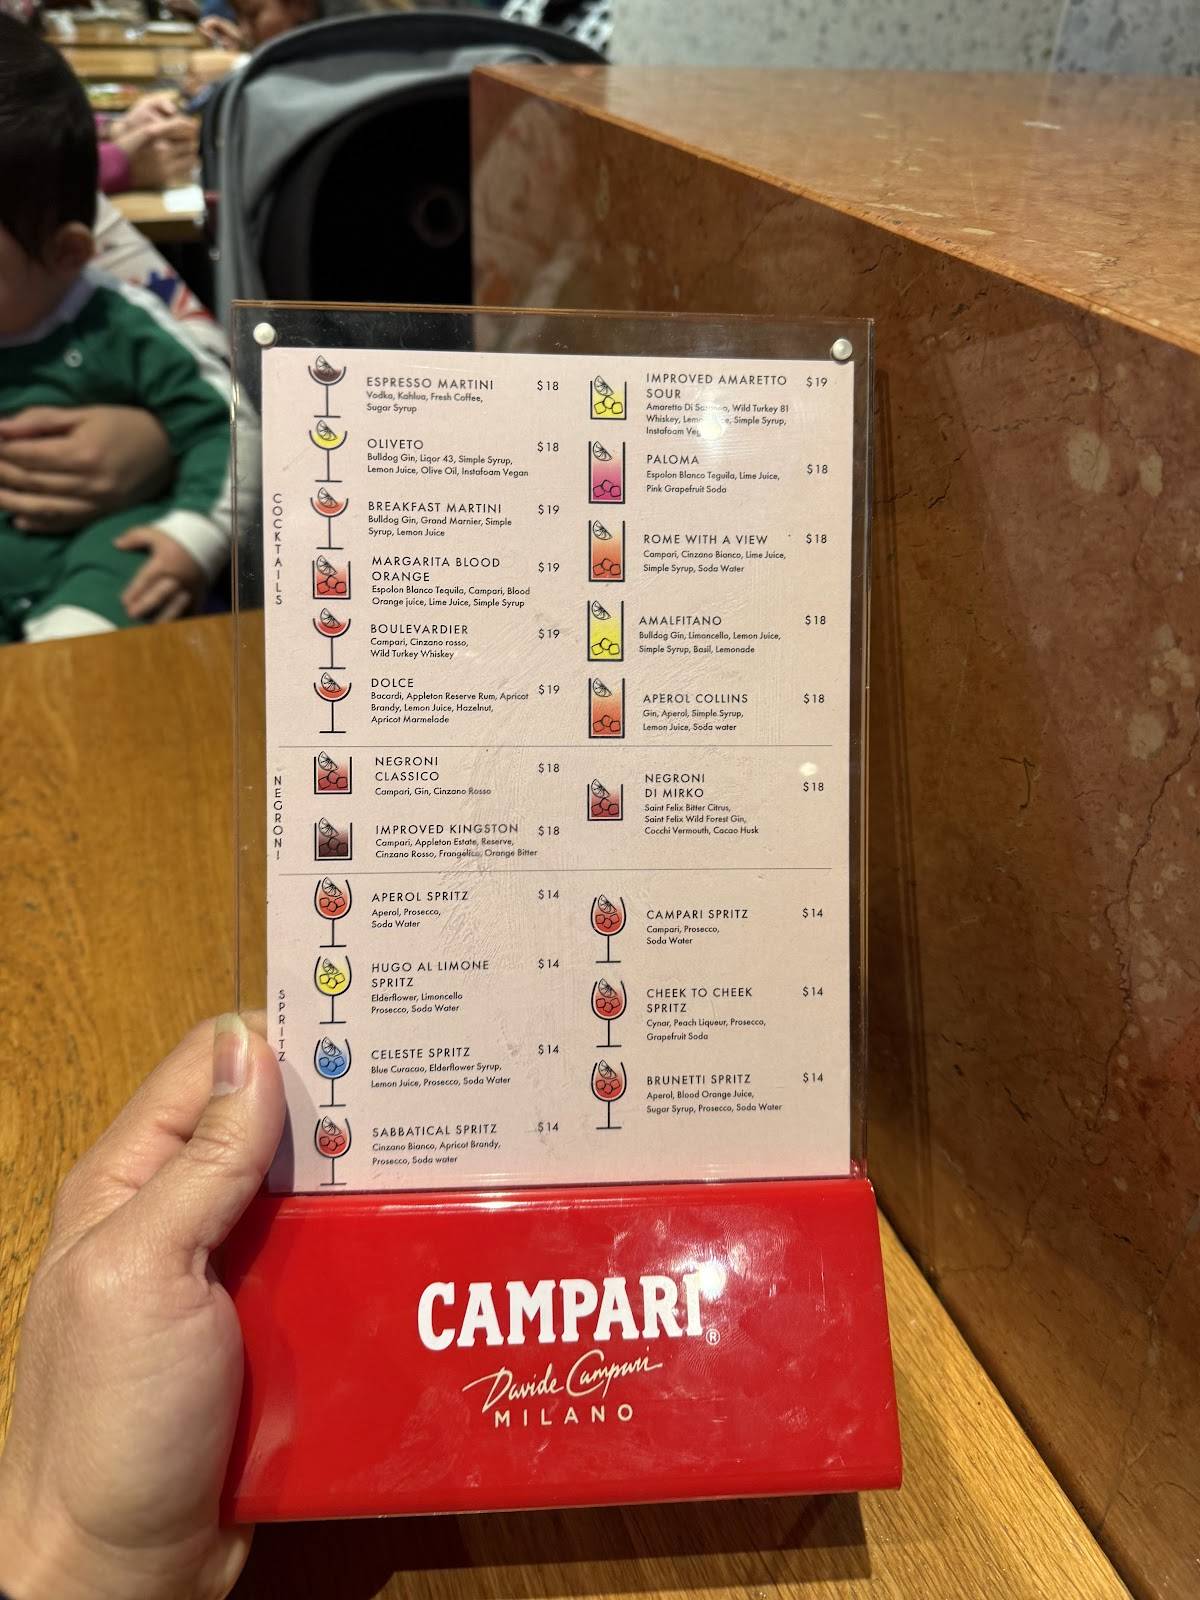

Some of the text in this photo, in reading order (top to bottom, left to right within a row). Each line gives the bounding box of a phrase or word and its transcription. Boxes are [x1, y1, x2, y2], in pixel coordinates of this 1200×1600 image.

[366, 376, 493, 390] ESPRESSO MARTINI
[646, 373, 787, 385] IMPROVED AMARETTO
[366, 390, 483, 403] Vodka, Kahlua, Fresh Coffee,
[646, 388, 681, 399] SOUR
[367, 438, 424, 449] OLIVETO
[367, 452, 399, 463] Bulldog
[442, 454, 456, 464] 43,
[458, 454, 486, 467] Simple
[487, 455, 513, 466] Syrup,
[647, 454, 699, 465] PALOMA
[646, 469, 677, 480] Espolon
[679, 470, 706, 479] Blanco
[739, 471, 757, 480] Lime
[758, 471, 780, 480] Juice,
[368, 501, 501, 513] BREAKFAST MARTINI
[368, 527, 445, 538] Syrup, Lemon Juice
[643, 534, 768, 544] ROME WITH A VIEW
[272, 493, 283, 606] COCKTAILS
[371, 556, 500, 567] MARGARITA BLOOD
[643, 563, 744, 574] Simple Syrup, Soda Water
[371, 571, 430, 581] ORANGE
[371, 597, 525, 609] Orange juice, Lime Juice, Simple Syrup
[638, 615, 722, 625] AMALFITANO
[370, 623, 468, 634] BOULEVARDIER
[370, 648, 454, 660] Wild Turkey Whiskey
[639, 644, 755, 655] Simple Syrup, Basil, Lemonade
[371, 678, 414, 687] DOLCE
[642, 693, 748, 703] APEROL COLLINS
[370, 714, 449, 725] Apricot Marmelade
[643, 723, 668, 731] Lemon
[669, 723, 690, 731] Juice,
[692, 722, 713, 730] Soda
[375, 756, 438, 766] NEGRONI
[375, 771, 439, 781] CLASSICO
[645, 773, 704, 783] NEGRONI
[374, 787, 412, 797] Campari,
[433, 787, 467, 795] Cinzano
[645, 788, 704, 798] DI MIRKO
[644, 803, 731, 813] Saint Felix Bitter Citrus,
[273, 776, 284, 860] NEGRONI
[376, 823, 518, 835] IMPROVED KINGSTON
[644, 825, 759, 835] Cocchi Vermouth, Cacao Husk
[371, 891, 468, 902] APEROL SPRITZ
[371, 907, 441, 918] Aperol, Prosecco,
[646, 909, 748, 919] CAMPARI SPRITZ
[646, 924, 720, 935] Campari, Prosecco,
[371, 960, 488, 973] HUGO AL LIMONE
[371, 977, 413, 988] SPRITZ
[371, 991, 463, 1003] Elderflower, Limoncello
[646, 987, 752, 998] CHEEK TO CHEEK
[646, 1003, 687, 1013] SPRITZ
[278, 989, 287, 1062] SPRITZ
[646, 1017, 766, 1029] Cynar, Peach Liqueur, Prosecco,
[646, 1031, 708, 1043] Grapefruit Soda
[371, 1047, 470, 1060] CELESTE SPRITZ
[371, 1062, 502, 1074] Blue Curacao, Elderflower Syrup,
[647, 1074, 751, 1085] BRUNETTI SPRITZ
[646, 1089, 754, 1101] Aperol, Blood Orange Juice,
[372, 1123, 496, 1137] SABBATICAL SPRITZ
[372, 1139, 501, 1151] Cinzano Bianco, Apricot Brandy,
[417, 1272, 705, 1351] CAMPARI
[462, 1347, 663, 1413] Davide Campari
[494, 1403, 633, 1429] MILANO
